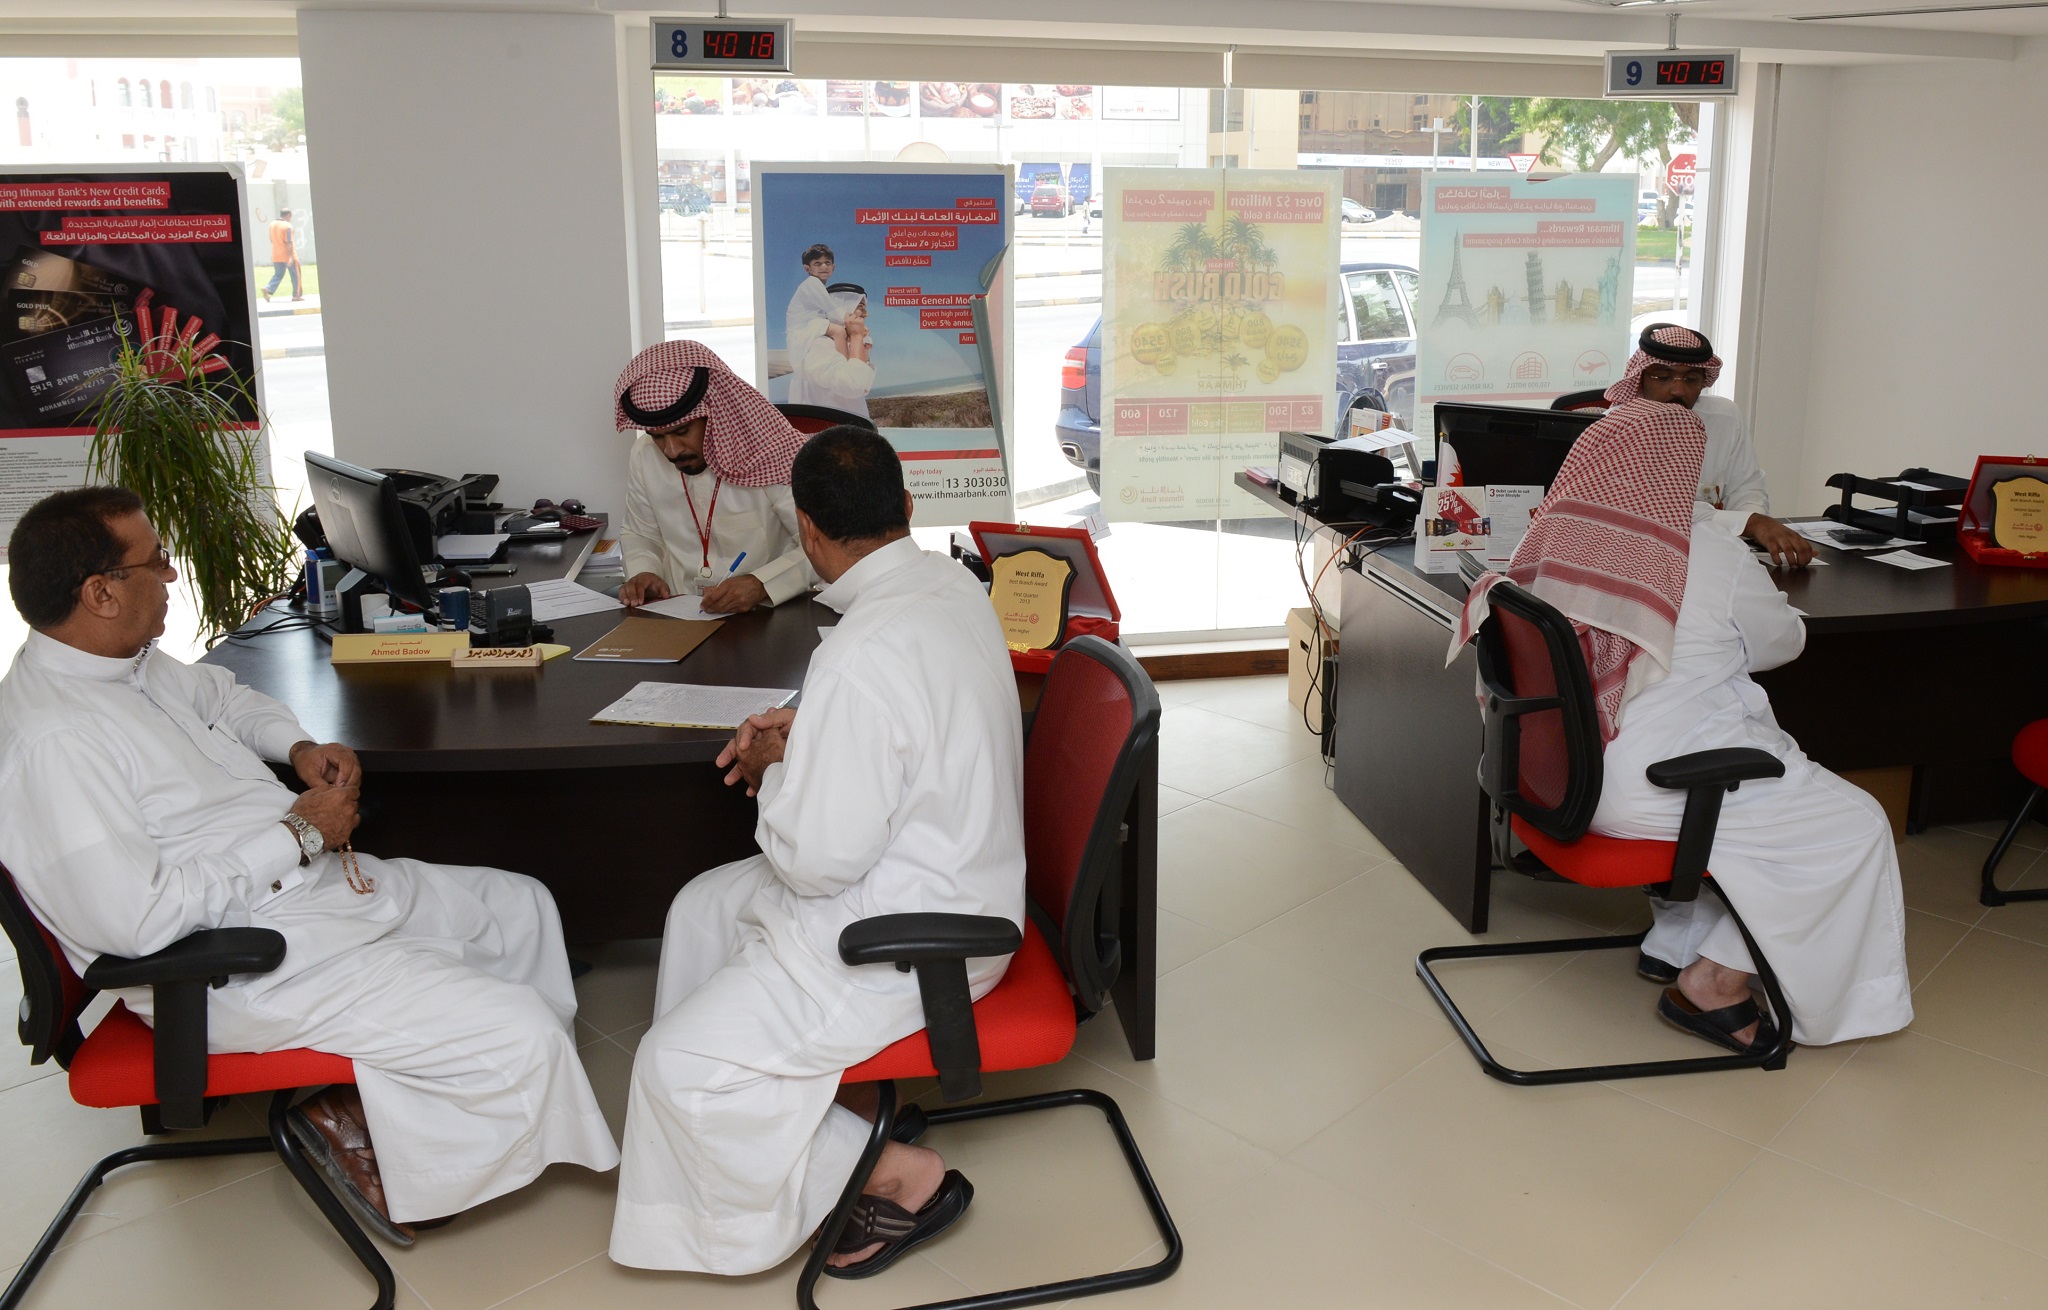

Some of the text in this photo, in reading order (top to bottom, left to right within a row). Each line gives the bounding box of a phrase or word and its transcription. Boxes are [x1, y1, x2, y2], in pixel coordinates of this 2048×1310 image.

[672, 30, 688, 58] 8
[706, 32, 774, 58] 4018
[1626, 61, 1642, 86] 9
[1660, 62, 1724, 84] 4019
[1670, 175, 1694, 186] STO
[20, 188, 55, 197] Ithmaar
[58, 187, 87, 197] Bank's
[90, 187, 110, 196] New
[113, 186, 139, 196] Credit
[141, 186, 168, 196] Cards.
[18, 198, 62, 208] extended
[64, 199, 101, 207] rewards
[104, 198, 121, 206] and
[124, 197, 164, 206] benefits.
[861, 212, 996, 224] المضاربة العامة لبنك الإثمار
[152, 232, 166, 242] من
[168, 231, 193, 240] المزيد
[195, 232, 209, 242] مع
[22, 258, 38, 268] GOLD
[886, 297, 919, 305] Ithmaar
[921, 297, 953, 305] General
[922, 311, 969, 319] Expect high profit
[68, 333, 114, 351] Ithmaar Bank
[946, 477, 1007, 488] 13 303030
[912, 490, 1007, 499] www.ithmaarbank.com
[1490, 488, 1495, 497] 3
[1438, 494, 1458, 513] 25%
